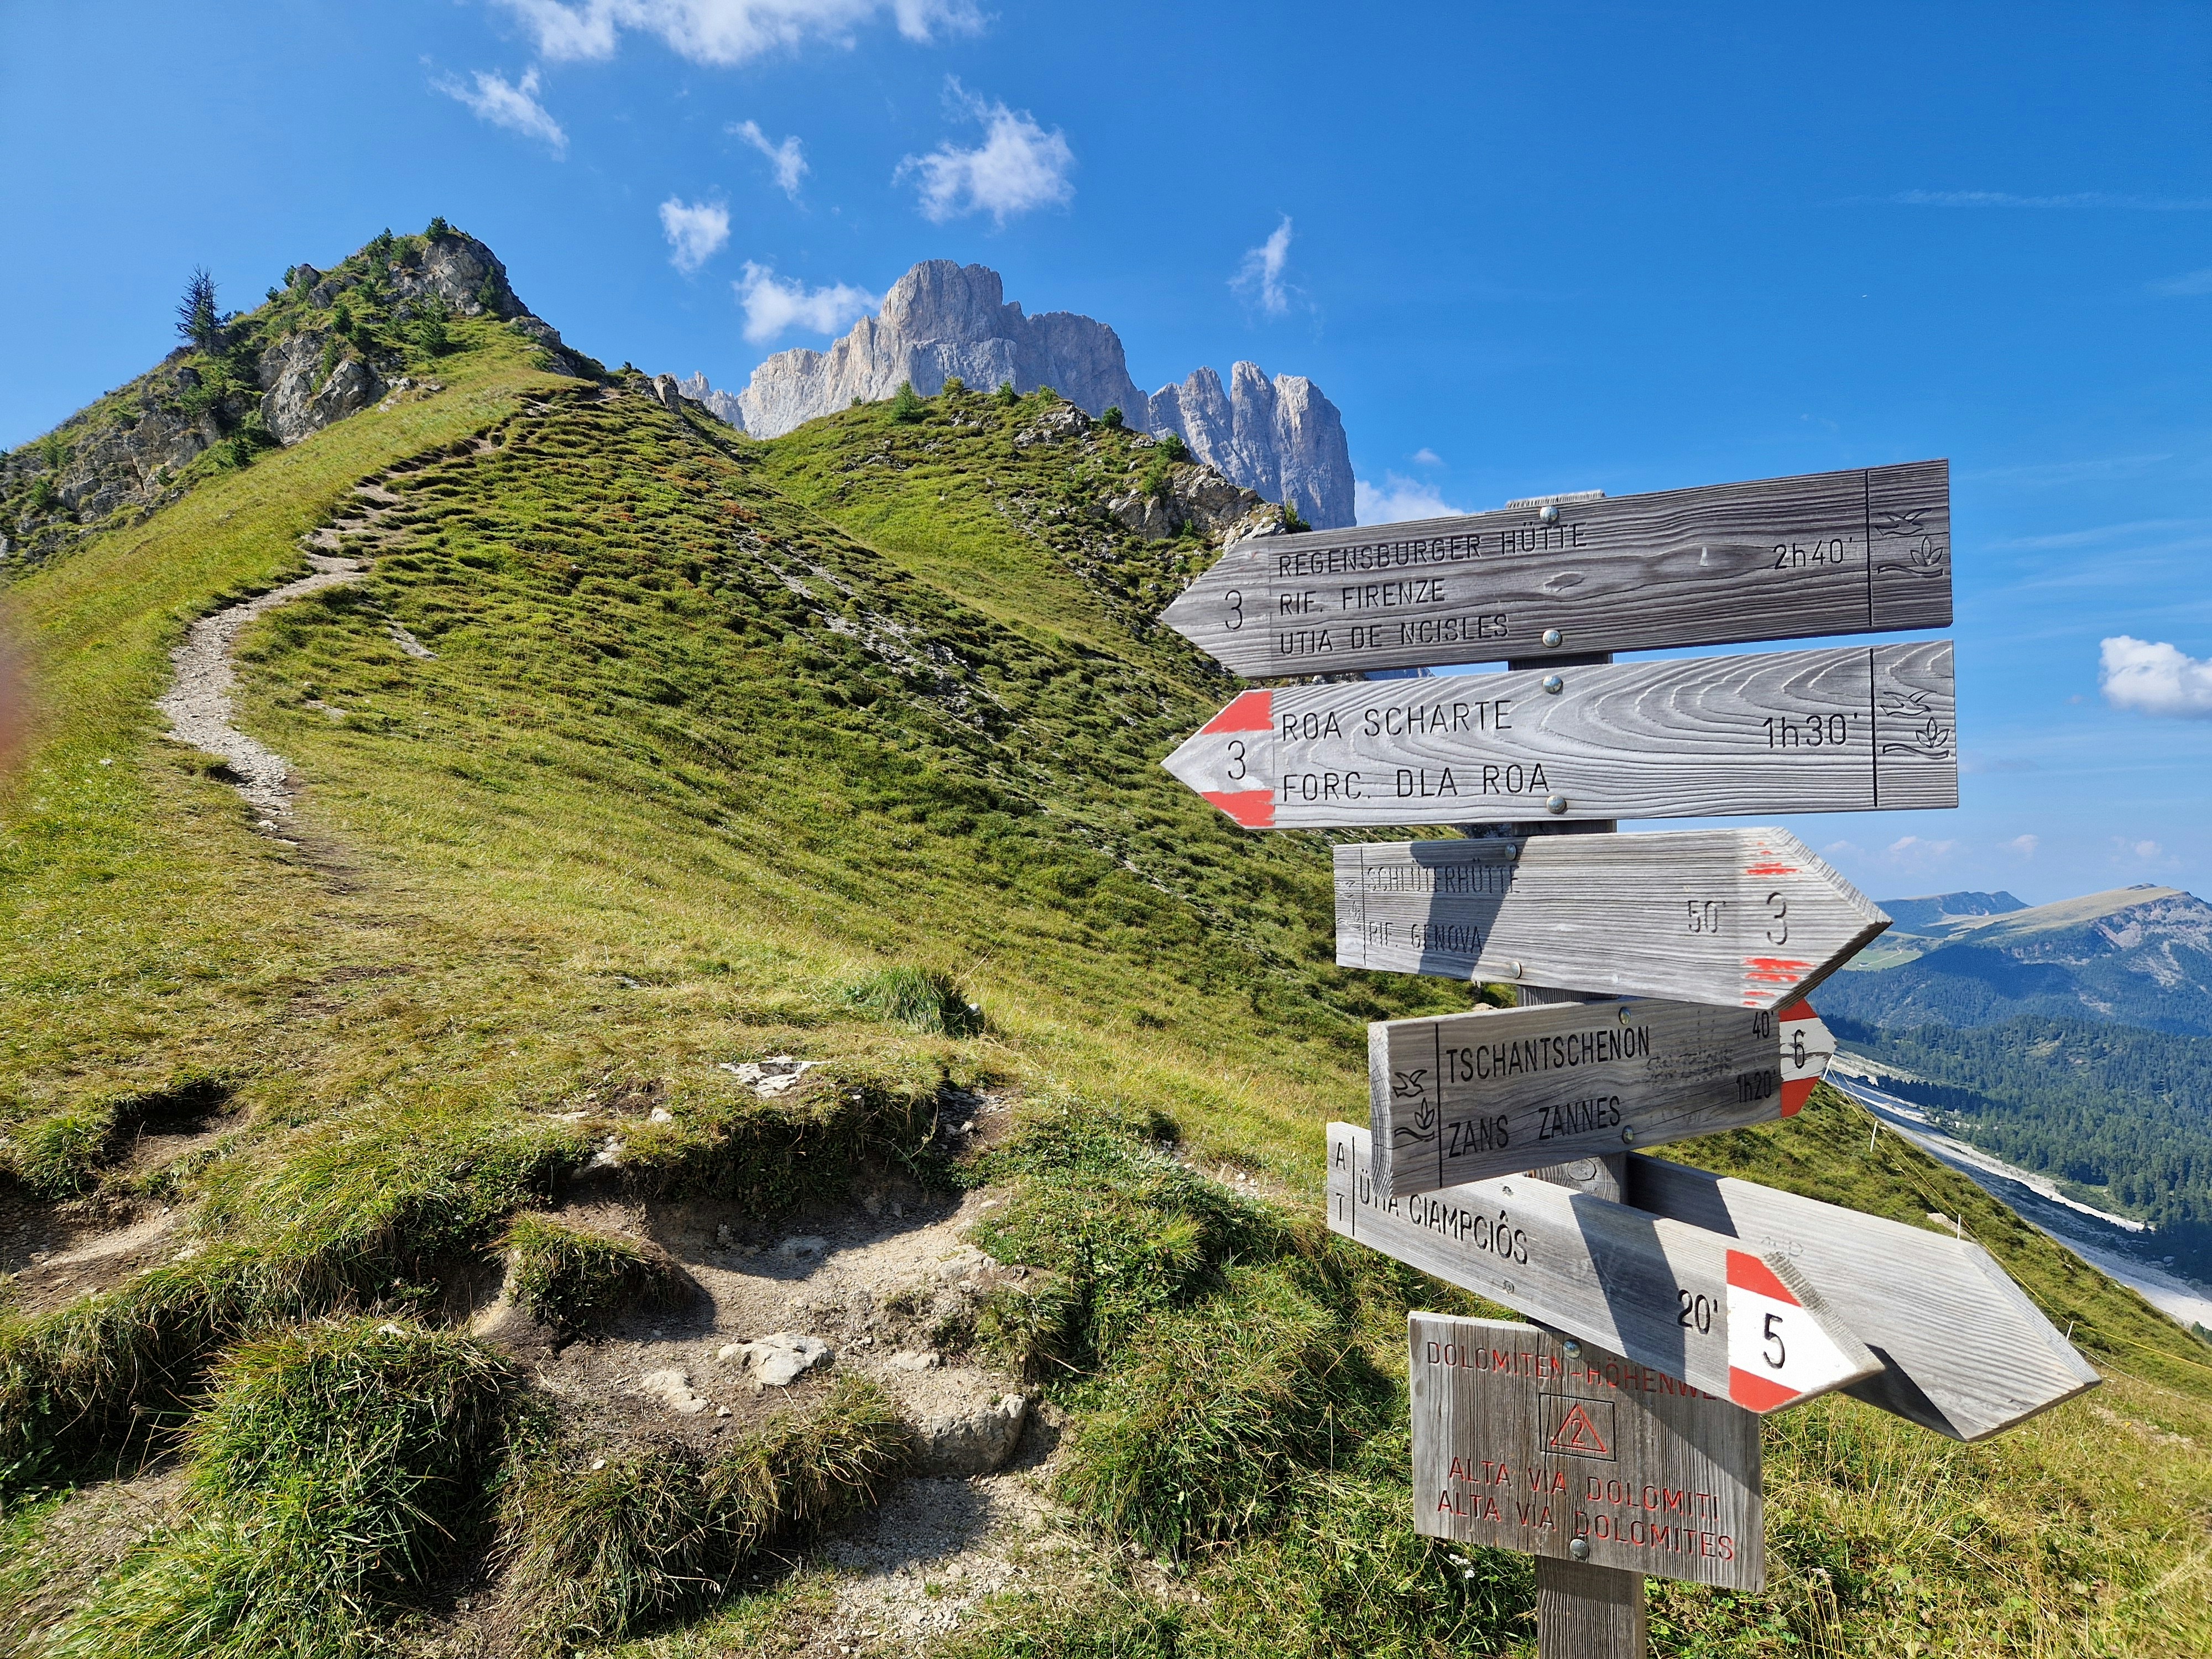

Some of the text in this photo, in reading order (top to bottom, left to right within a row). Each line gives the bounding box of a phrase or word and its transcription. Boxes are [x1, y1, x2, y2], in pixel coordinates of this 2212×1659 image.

[1278, 521, 1587, 578] REGENSBURGER HÜTTE
[1772, 537, 1853, 570] 2h40'
[1224, 590, 1243, 631] 3
[1279, 578, 1446, 615] RIF. FIRENZE
[1279, 613, 1508, 655] UTIA DE NCISLES
[1282, 700, 1512, 742] ROA SCHARTE
[1762, 713, 1858, 749] 1h30'
[1227, 740, 1246, 780] 3
[1283, 763, 1550, 802] FORC. DLA ROA
[1368, 857, 1520, 894] SCHLÜTERHÜTTE
[1688, 900, 1726, 933] 50'
[1766, 891, 1787, 946] 3
[1411, 924, 1483, 954] GENOVA
[1752, 1010, 1774, 1039] 40'
[1446, 1026, 1650, 1083] TSCHANTSCHENON
[1793, 1029, 1806, 1068] 6
[1736, 1070, 1776, 1103] 1h20'
[1448, 1095, 1621, 1158] ZANS ZANNES
[1336, 1141, 1345, 1170] A
[1336, 1192, 1344, 1221] T
[1677, 1289, 1718, 1334] 20'
[1763, 1313, 1785, 1369] 5
[1427, 1340, 1729, 1402] DOLOMITEN-HÖHENW
[1571, 1418, 1584, 1444] 2
[1449, 1457, 1719, 1521] ALTA VIA DOLOMITI
[1437, 1490, 1734, 1562] ALTA VIA DOLOMITES
